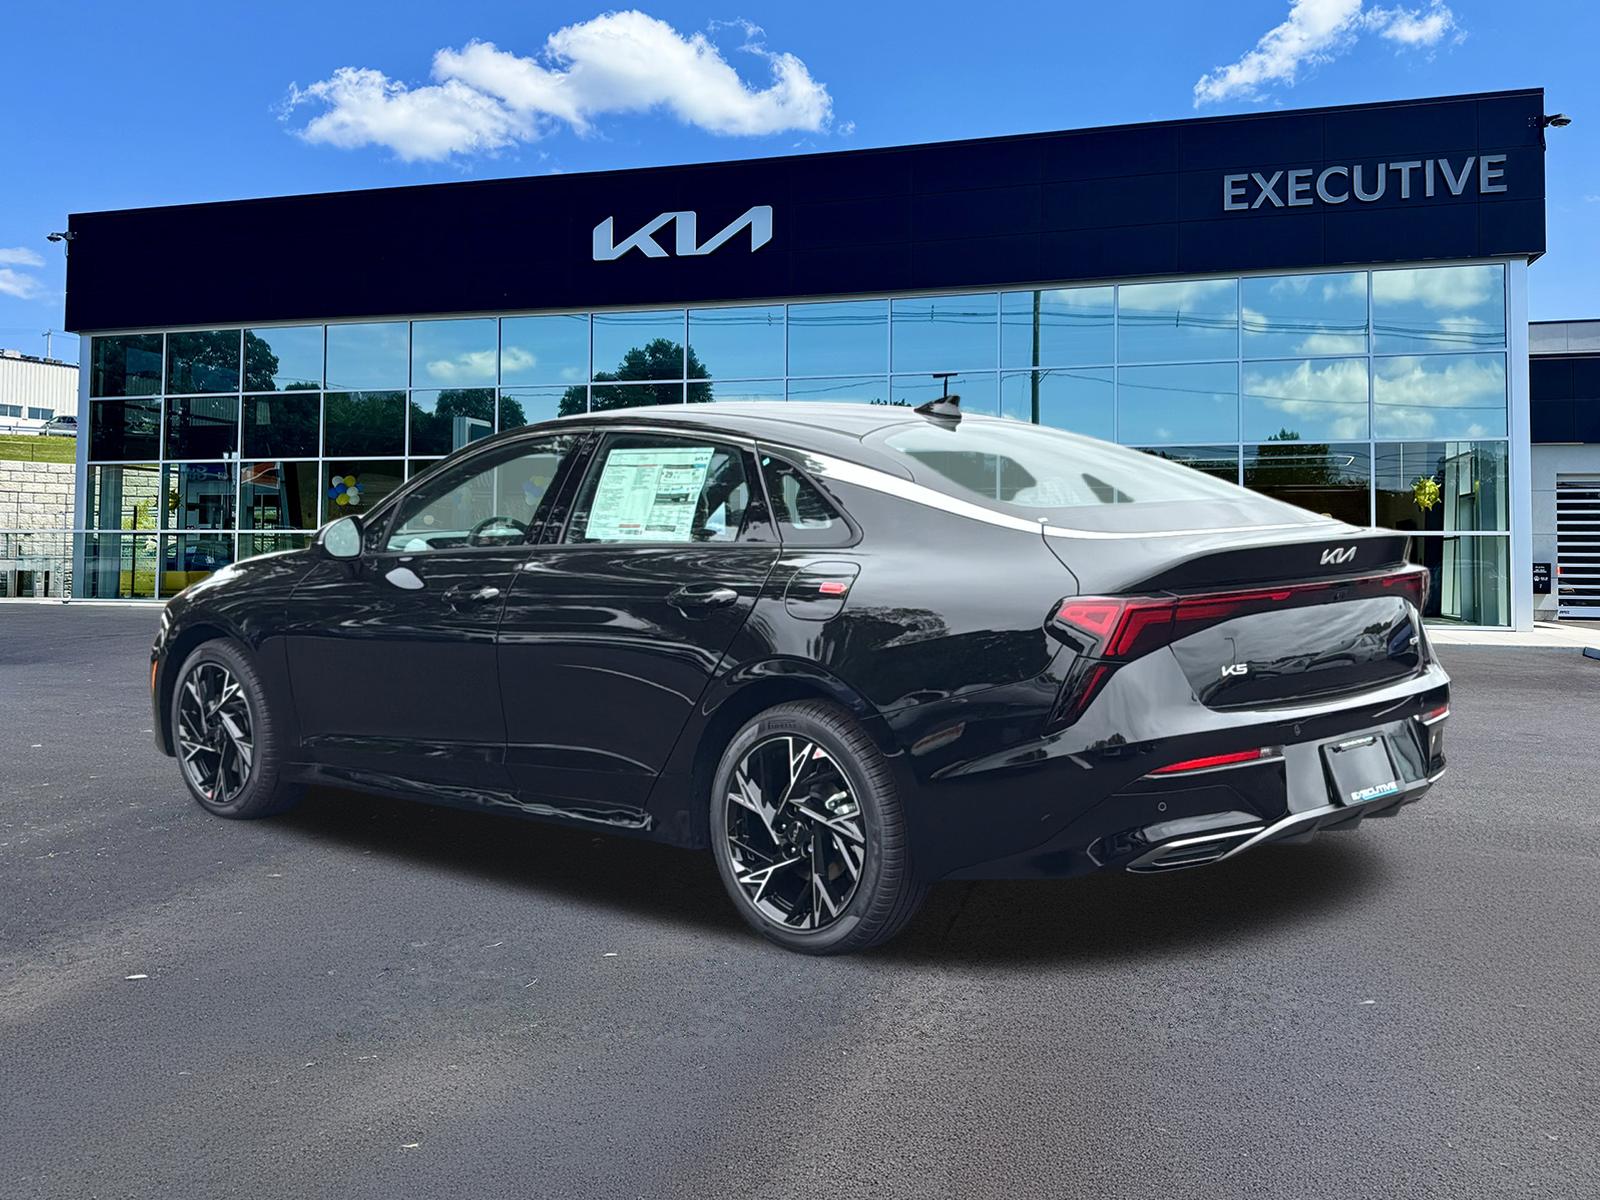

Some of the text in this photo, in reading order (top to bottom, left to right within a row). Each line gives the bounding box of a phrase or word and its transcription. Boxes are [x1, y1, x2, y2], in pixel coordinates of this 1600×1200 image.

[1223, 154, 1508, 211] EXECUTIVE
[593, 205, 773, 261] KIA
[1320, 546, 1357, 565] KIA
[1221, 664, 1248, 677] K5
